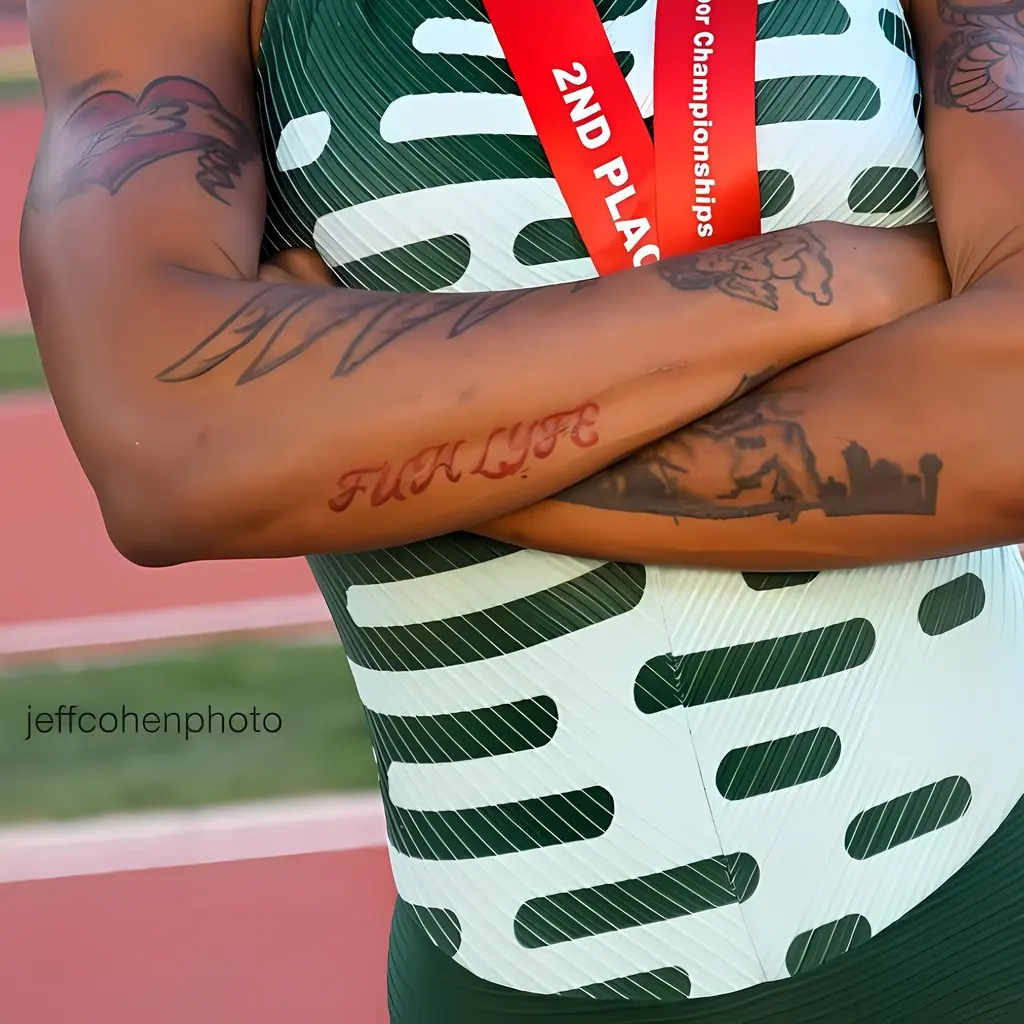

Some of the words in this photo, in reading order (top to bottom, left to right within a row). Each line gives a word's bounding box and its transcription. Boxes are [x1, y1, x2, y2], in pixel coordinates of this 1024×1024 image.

[551, 61, 612, 150] 2ND
[688, 31, 716, 238] Championships
[469, 401, 600, 480] LYFE
